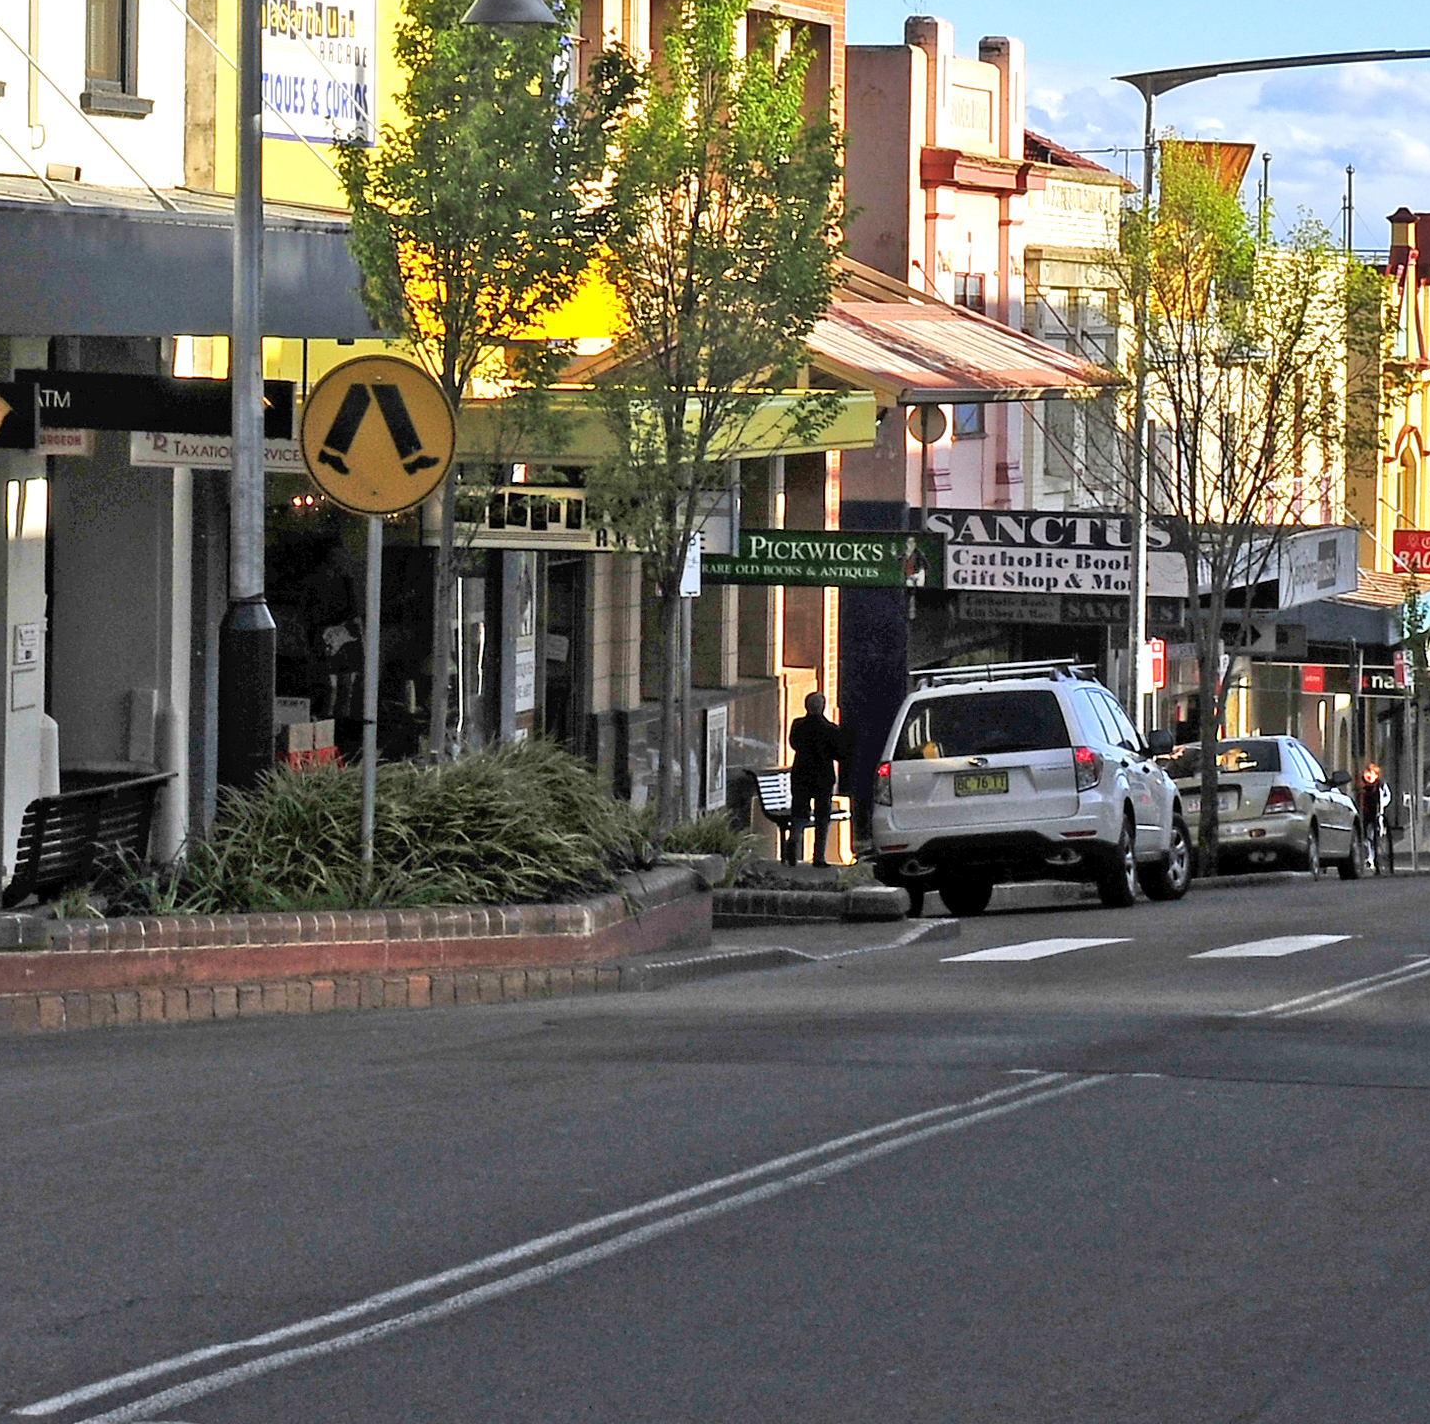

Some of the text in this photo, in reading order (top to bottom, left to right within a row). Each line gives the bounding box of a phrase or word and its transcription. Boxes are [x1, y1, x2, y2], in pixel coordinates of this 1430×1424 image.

[320, 41, 368, 67] ARCADE
[311, 78, 320, 115] &
[326, 80, 369, 121] CURIOS
[926, 513, 1172, 548] SANCTUS
[749, 536, 884, 561] PICKWICK'S
[952, 549, 1069, 569] Catholic
[702, 564, 880, 578] RARE OLD BOOKS & ANTIQUES
[952, 569, 997, 586] Gift
[1002, 571, 1059, 591] Shop
[1065, 573, 1083, 589] &
[1371, 675, 1395, 689] na
